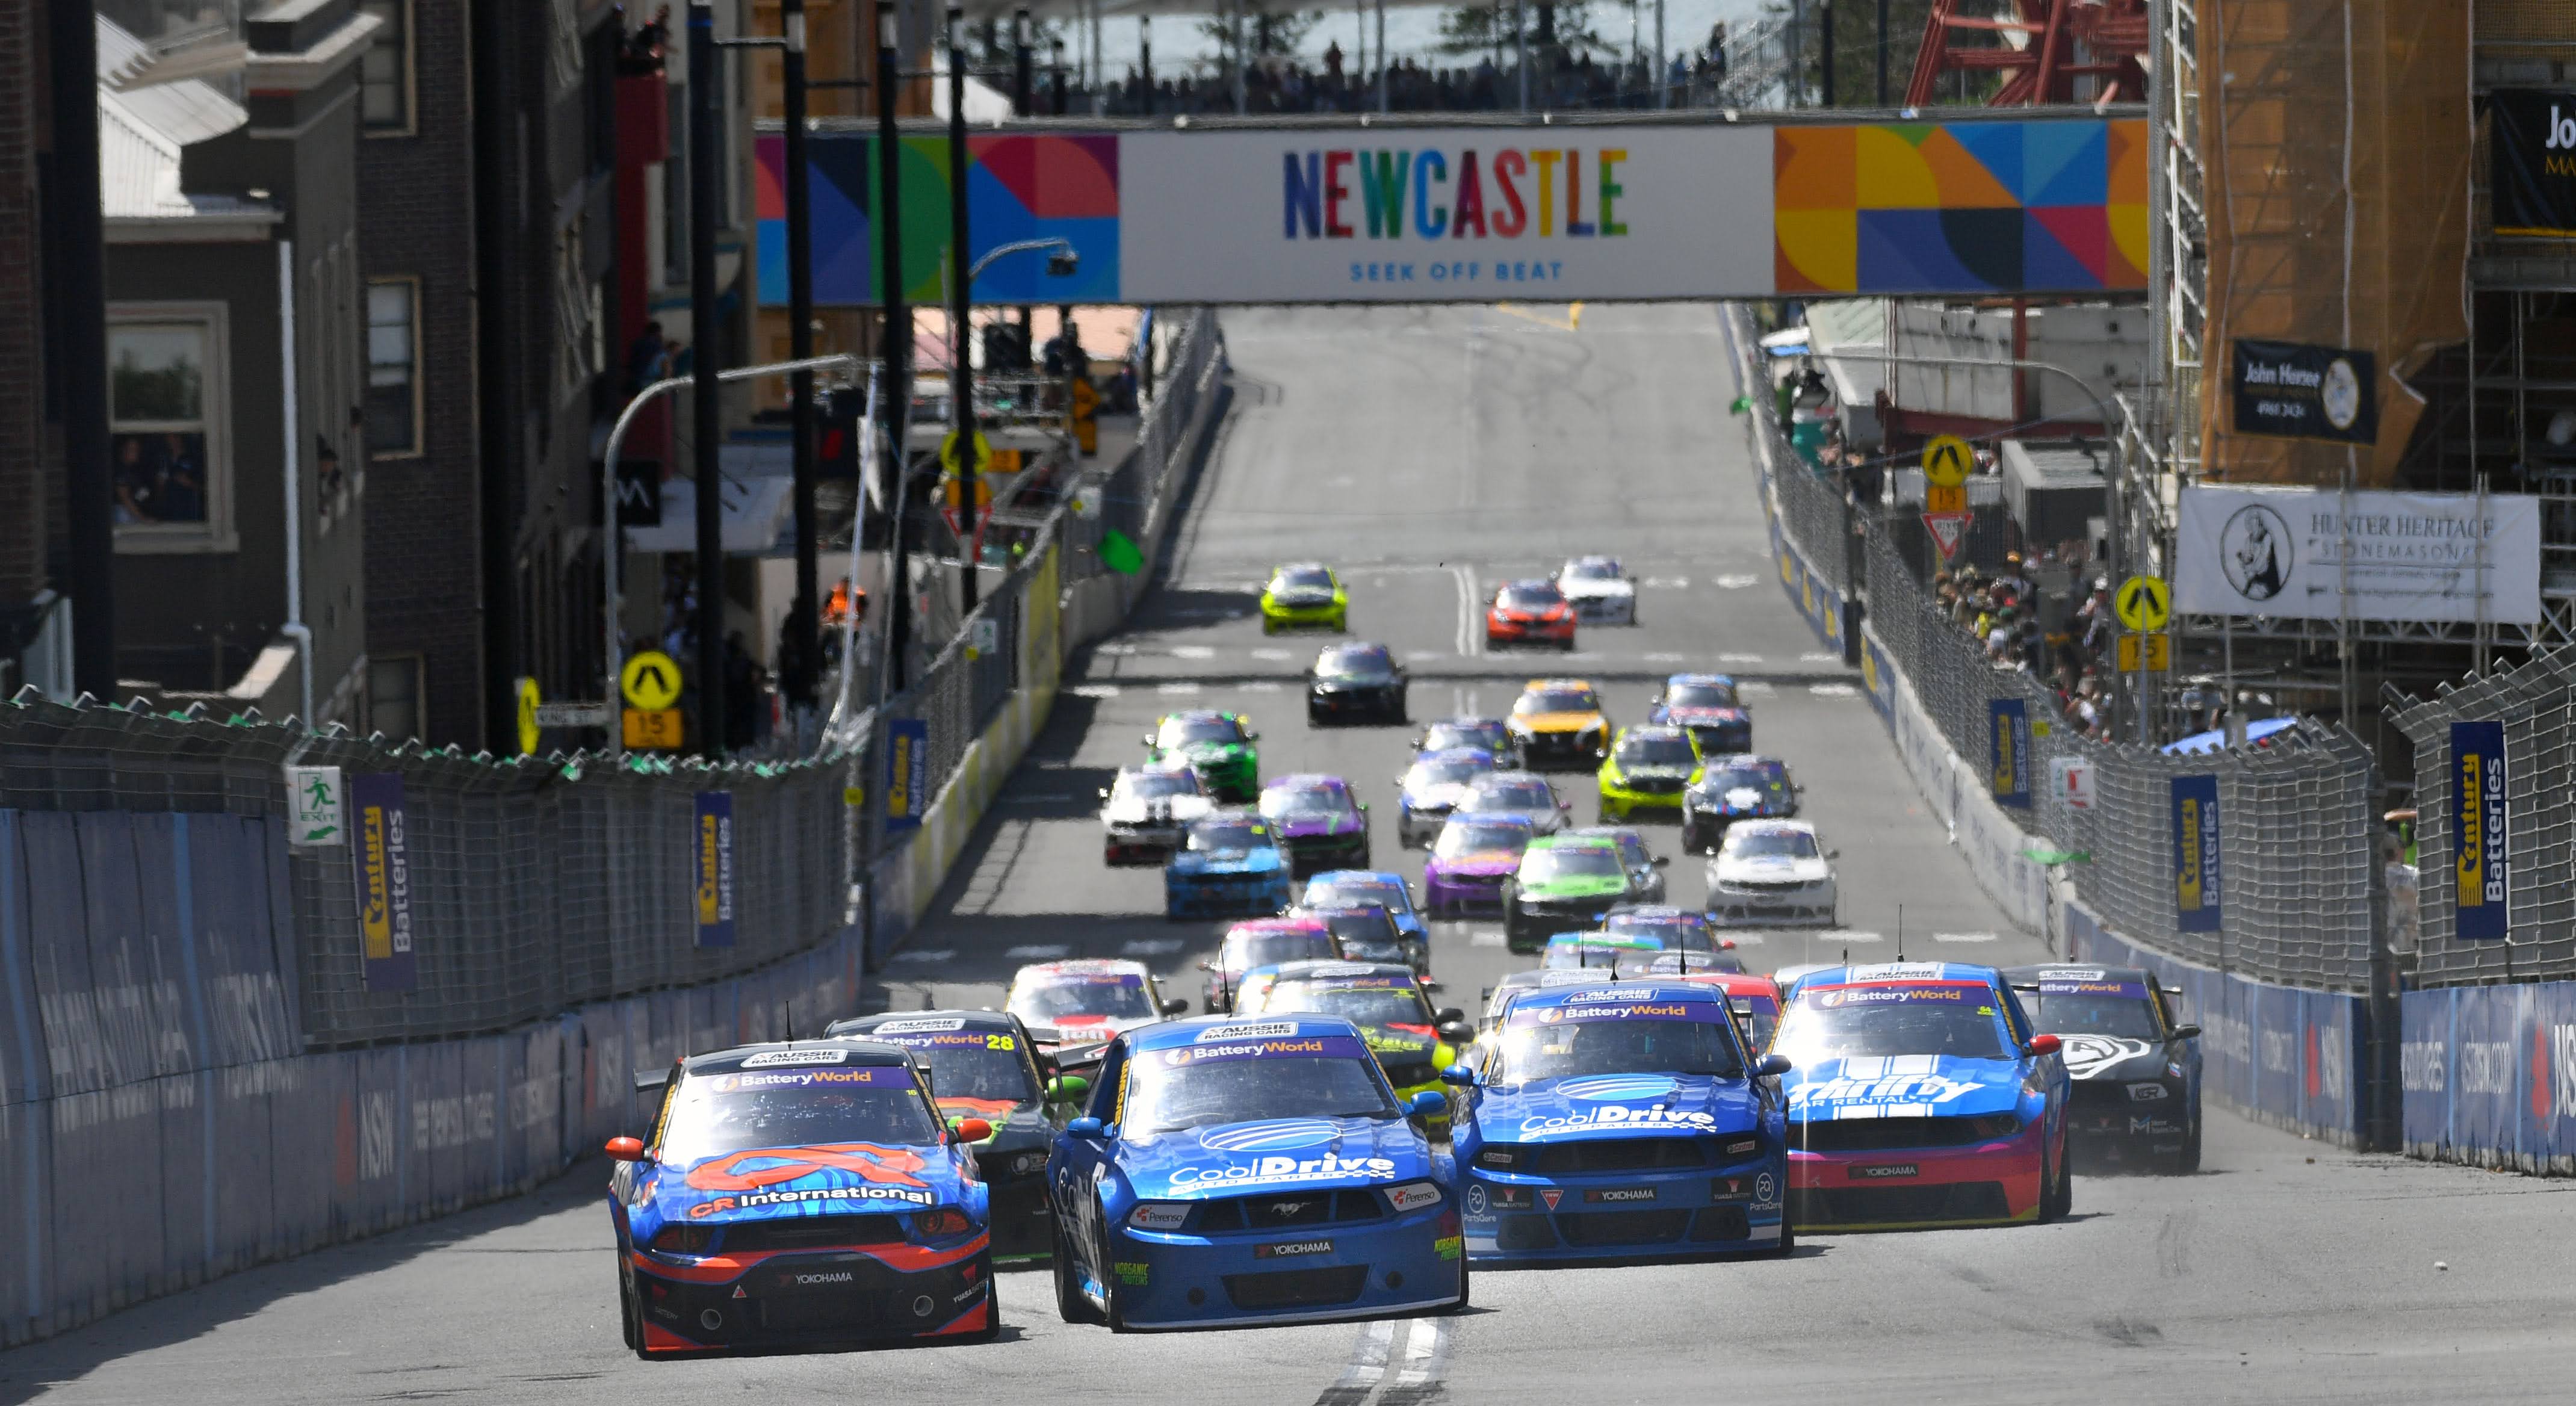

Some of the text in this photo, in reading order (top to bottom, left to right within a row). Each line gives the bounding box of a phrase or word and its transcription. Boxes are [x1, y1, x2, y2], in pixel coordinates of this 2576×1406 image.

[1284, 148, 1627, 240] NEWCASTLE
[1351, 262, 1562, 282] SEEK OFF BEAT
[2244, 362, 2277, 383] John
[2311, 515, 2391, 536] HUNTER
[639, 714, 664, 734] 15
[300, 813, 337, 822] EXIT
[2457, 754, 2503, 907] Century Batteries
[2202, 802, 2219, 906] Batteries
[387, 810, 412, 952] Batteries
[1570, 995, 1615, 1003] RACING
[1585, 988, 1653, 998] AUSSIE
[897, 1018, 959, 1027] AUSSIE
[1222, 1023, 1292, 1033] AUSSIE
[1204, 1031, 1252, 1040] RACING
[986, 1034, 1015, 1051] 28
[770, 1050, 840, 1059] AUSSIE
[1832, 1096, 1910, 1105] RENTAL
[1520, 1104, 1715, 1132] CoolDrive
[1490, 1153, 1511, 1162] Castrol
[1169, 1152, 1395, 1186] CoolDrive
[1866, 1165, 1916, 1176] YOKOHAMA
[1406, 1191, 1435, 1203] Perenso
[1602, 1189, 1655, 1201] YOKOHAMA
[690, 1186, 932, 1218] CR International
[1149, 1212, 1183, 1223] Perenso
[1273, 1242, 1332, 1256] YOKOHAMA
[796, 1272, 853, 1284] YOKOHAMA
[953, 1288, 973, 1303] YUASA
